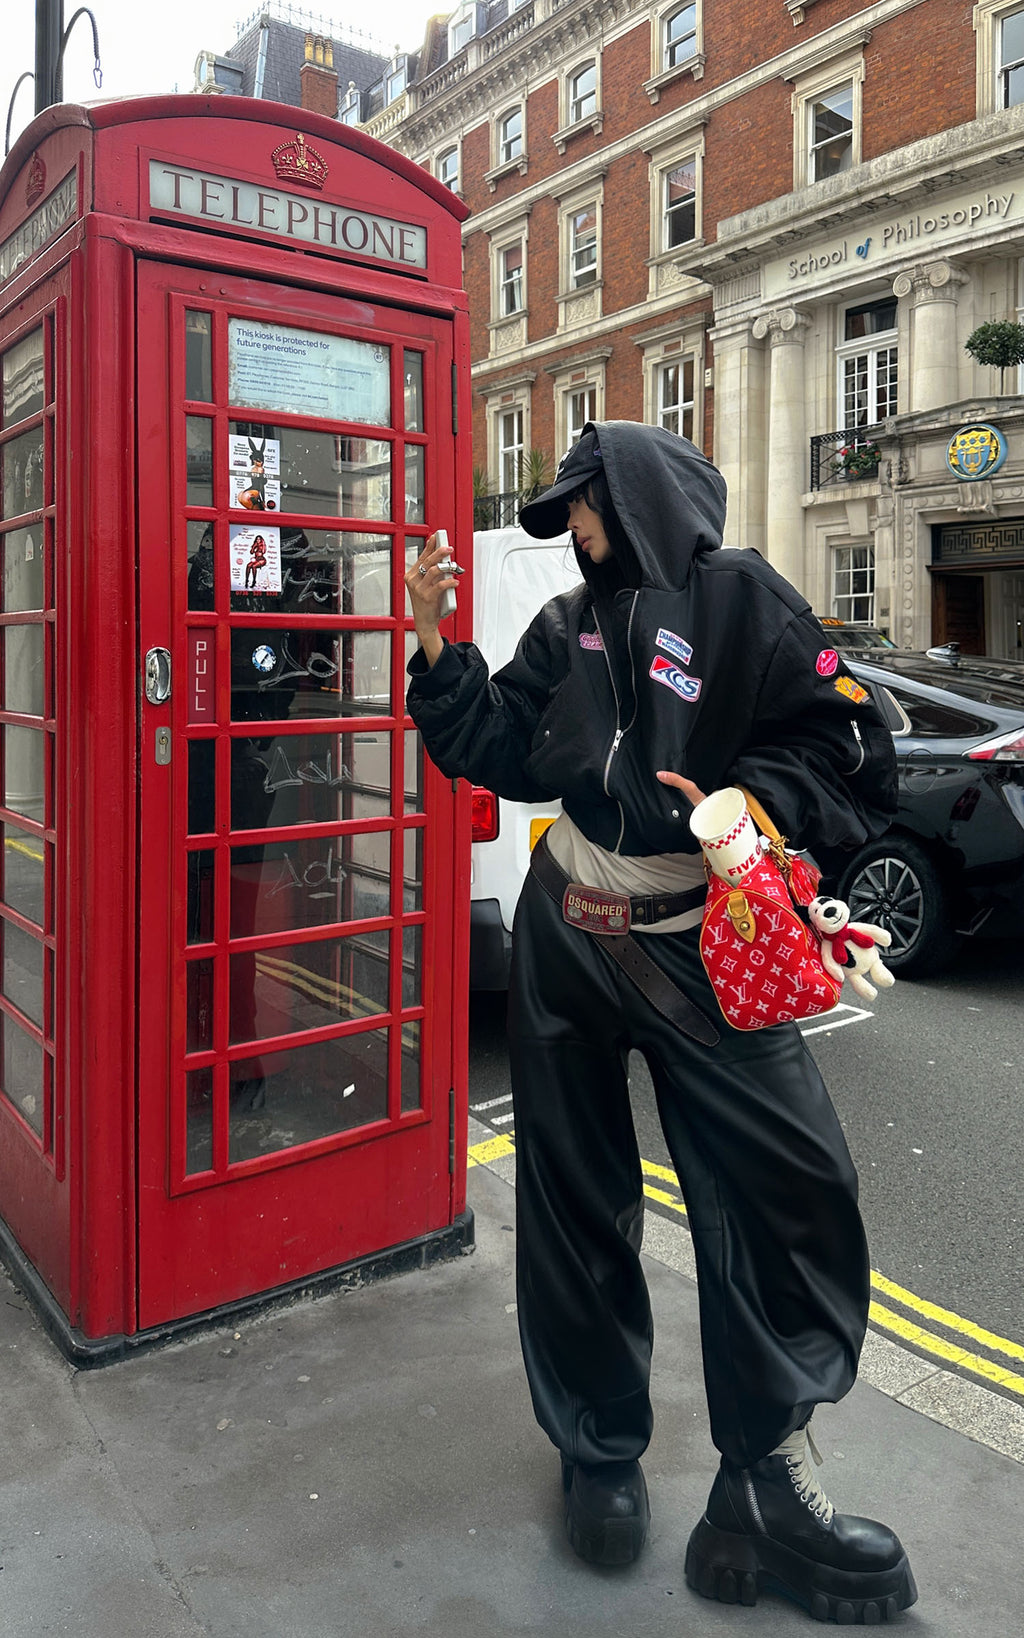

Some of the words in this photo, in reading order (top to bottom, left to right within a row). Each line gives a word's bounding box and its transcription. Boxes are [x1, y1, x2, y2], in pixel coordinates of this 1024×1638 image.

[162, 169, 418, 264] TELEPHONE
[788, 241, 848, 280] School
[855, 237, 872, 259] of
[881, 192, 1014, 248] Philosophy
[236, 327, 254, 338] This
[255, 330, 274, 341] kiosk
[276, 333, 282, 342] is
[282, 336, 319, 348] protected
[320, 341, 330, 350] for
[236, 337, 261, 349] future
[262, 343, 307, 356] generations
[195, 641, 207, 711] PULL
[656, 667, 699, 698] ACS
[727, 853, 757, 877] FIVE
